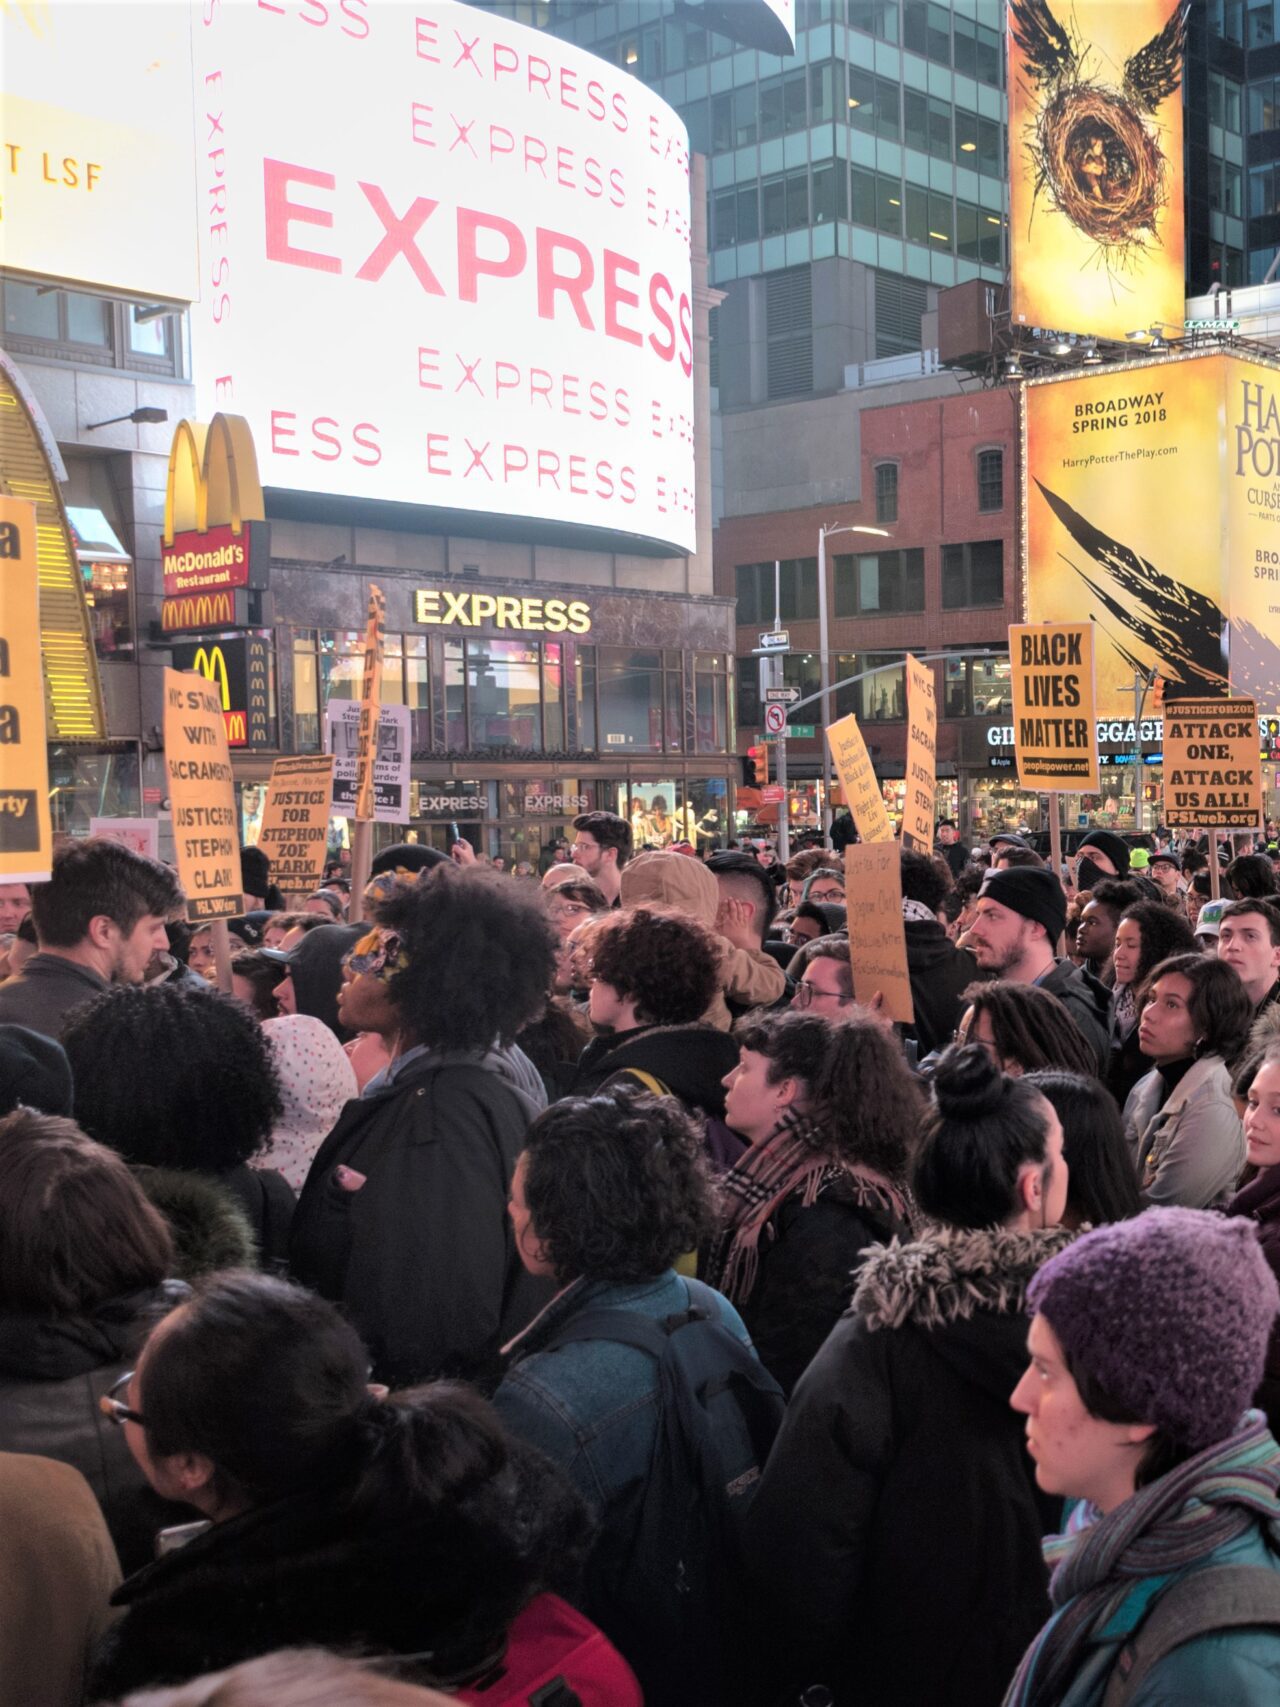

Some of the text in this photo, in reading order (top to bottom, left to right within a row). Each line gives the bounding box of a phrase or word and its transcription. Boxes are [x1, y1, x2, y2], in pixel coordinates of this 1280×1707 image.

[415, 16, 628, 133] EXPRESS
[412, 102, 626, 208] EXPRESS
[42, 152, 102, 191] LSF
[205, 71, 232, 324] EXPRESS
[263, 157, 692, 378] EXPRESS
[1188, 320, 1234, 328] LAMAR
[418, 346, 631, 427] EXPRESS
[1075, 392, 1164, 417] BROADWAY
[1072, 409, 1167, 434] SPRING 2018
[1062, 446, 1178, 468] HarryPotterThePlay.com
[427, 432, 637, 504] EXPRESS
[1259, 511, 1275, 522] PARTS
[164, 544, 244, 575] McDonald's
[176, 569, 231, 589] Restaurant
[415, 590, 592, 634] EXPRESS
[1021, 633, 1082, 666] BLACK
[1024, 674, 1080, 707] LIVES
[1166, 704, 1254, 715] #JUSTICEFORZOE
[183, 725, 217, 746] WITH
[1020, 718, 1088, 748] MATTER
[1169, 723, 1253, 739] ATTACK
[1187, 744, 1234, 761] ONE,
[168, 760, 232, 783] SACRAMENTO
[391, 764, 400, 772] of
[1170, 770, 1253, 785] ATTACK
[272, 791, 325, 805] JUSTICE
[419, 796, 489, 811] EXPRESS
[524, 794, 589, 809] EXPRESS
[1175, 792, 1249, 808] US ALL!
[177, 807, 224, 827] JUSTICE
[282, 808, 311, 823] FOR
[1168, 809, 1258, 826] PSLweb.org
[262, 827, 326, 842] STEPHON
[185, 838, 233, 858] STEPHON
[269, 858, 316, 874] CLARK!
